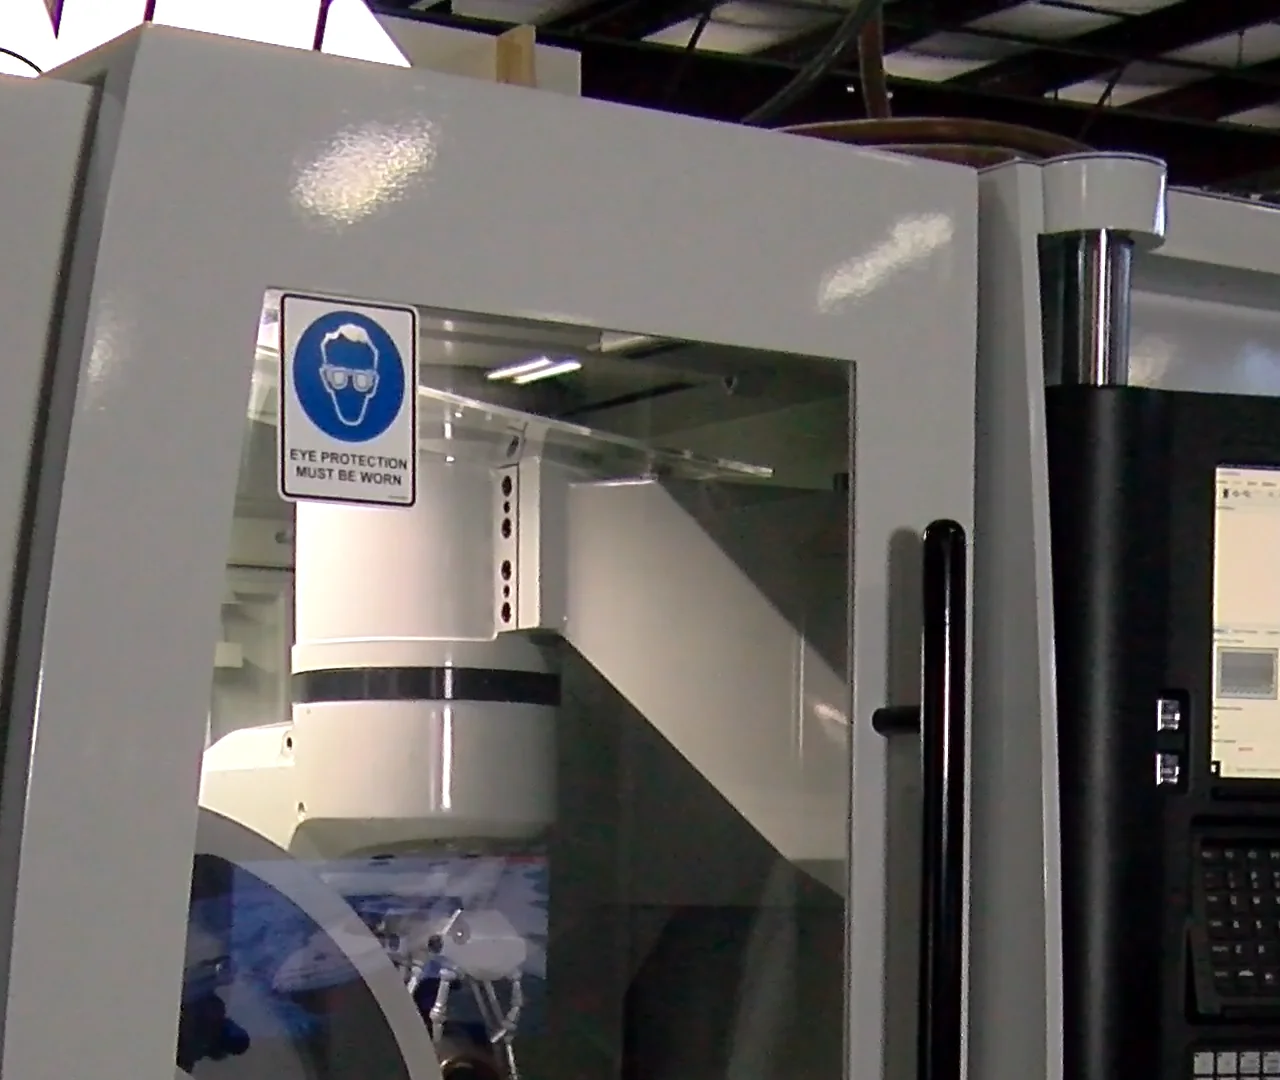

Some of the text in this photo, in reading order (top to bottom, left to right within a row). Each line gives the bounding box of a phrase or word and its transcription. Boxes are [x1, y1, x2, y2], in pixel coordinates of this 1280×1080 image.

[290, 448, 408, 470] EYE PROTECTION
[296, 466, 402, 486] MUST BE WORN
